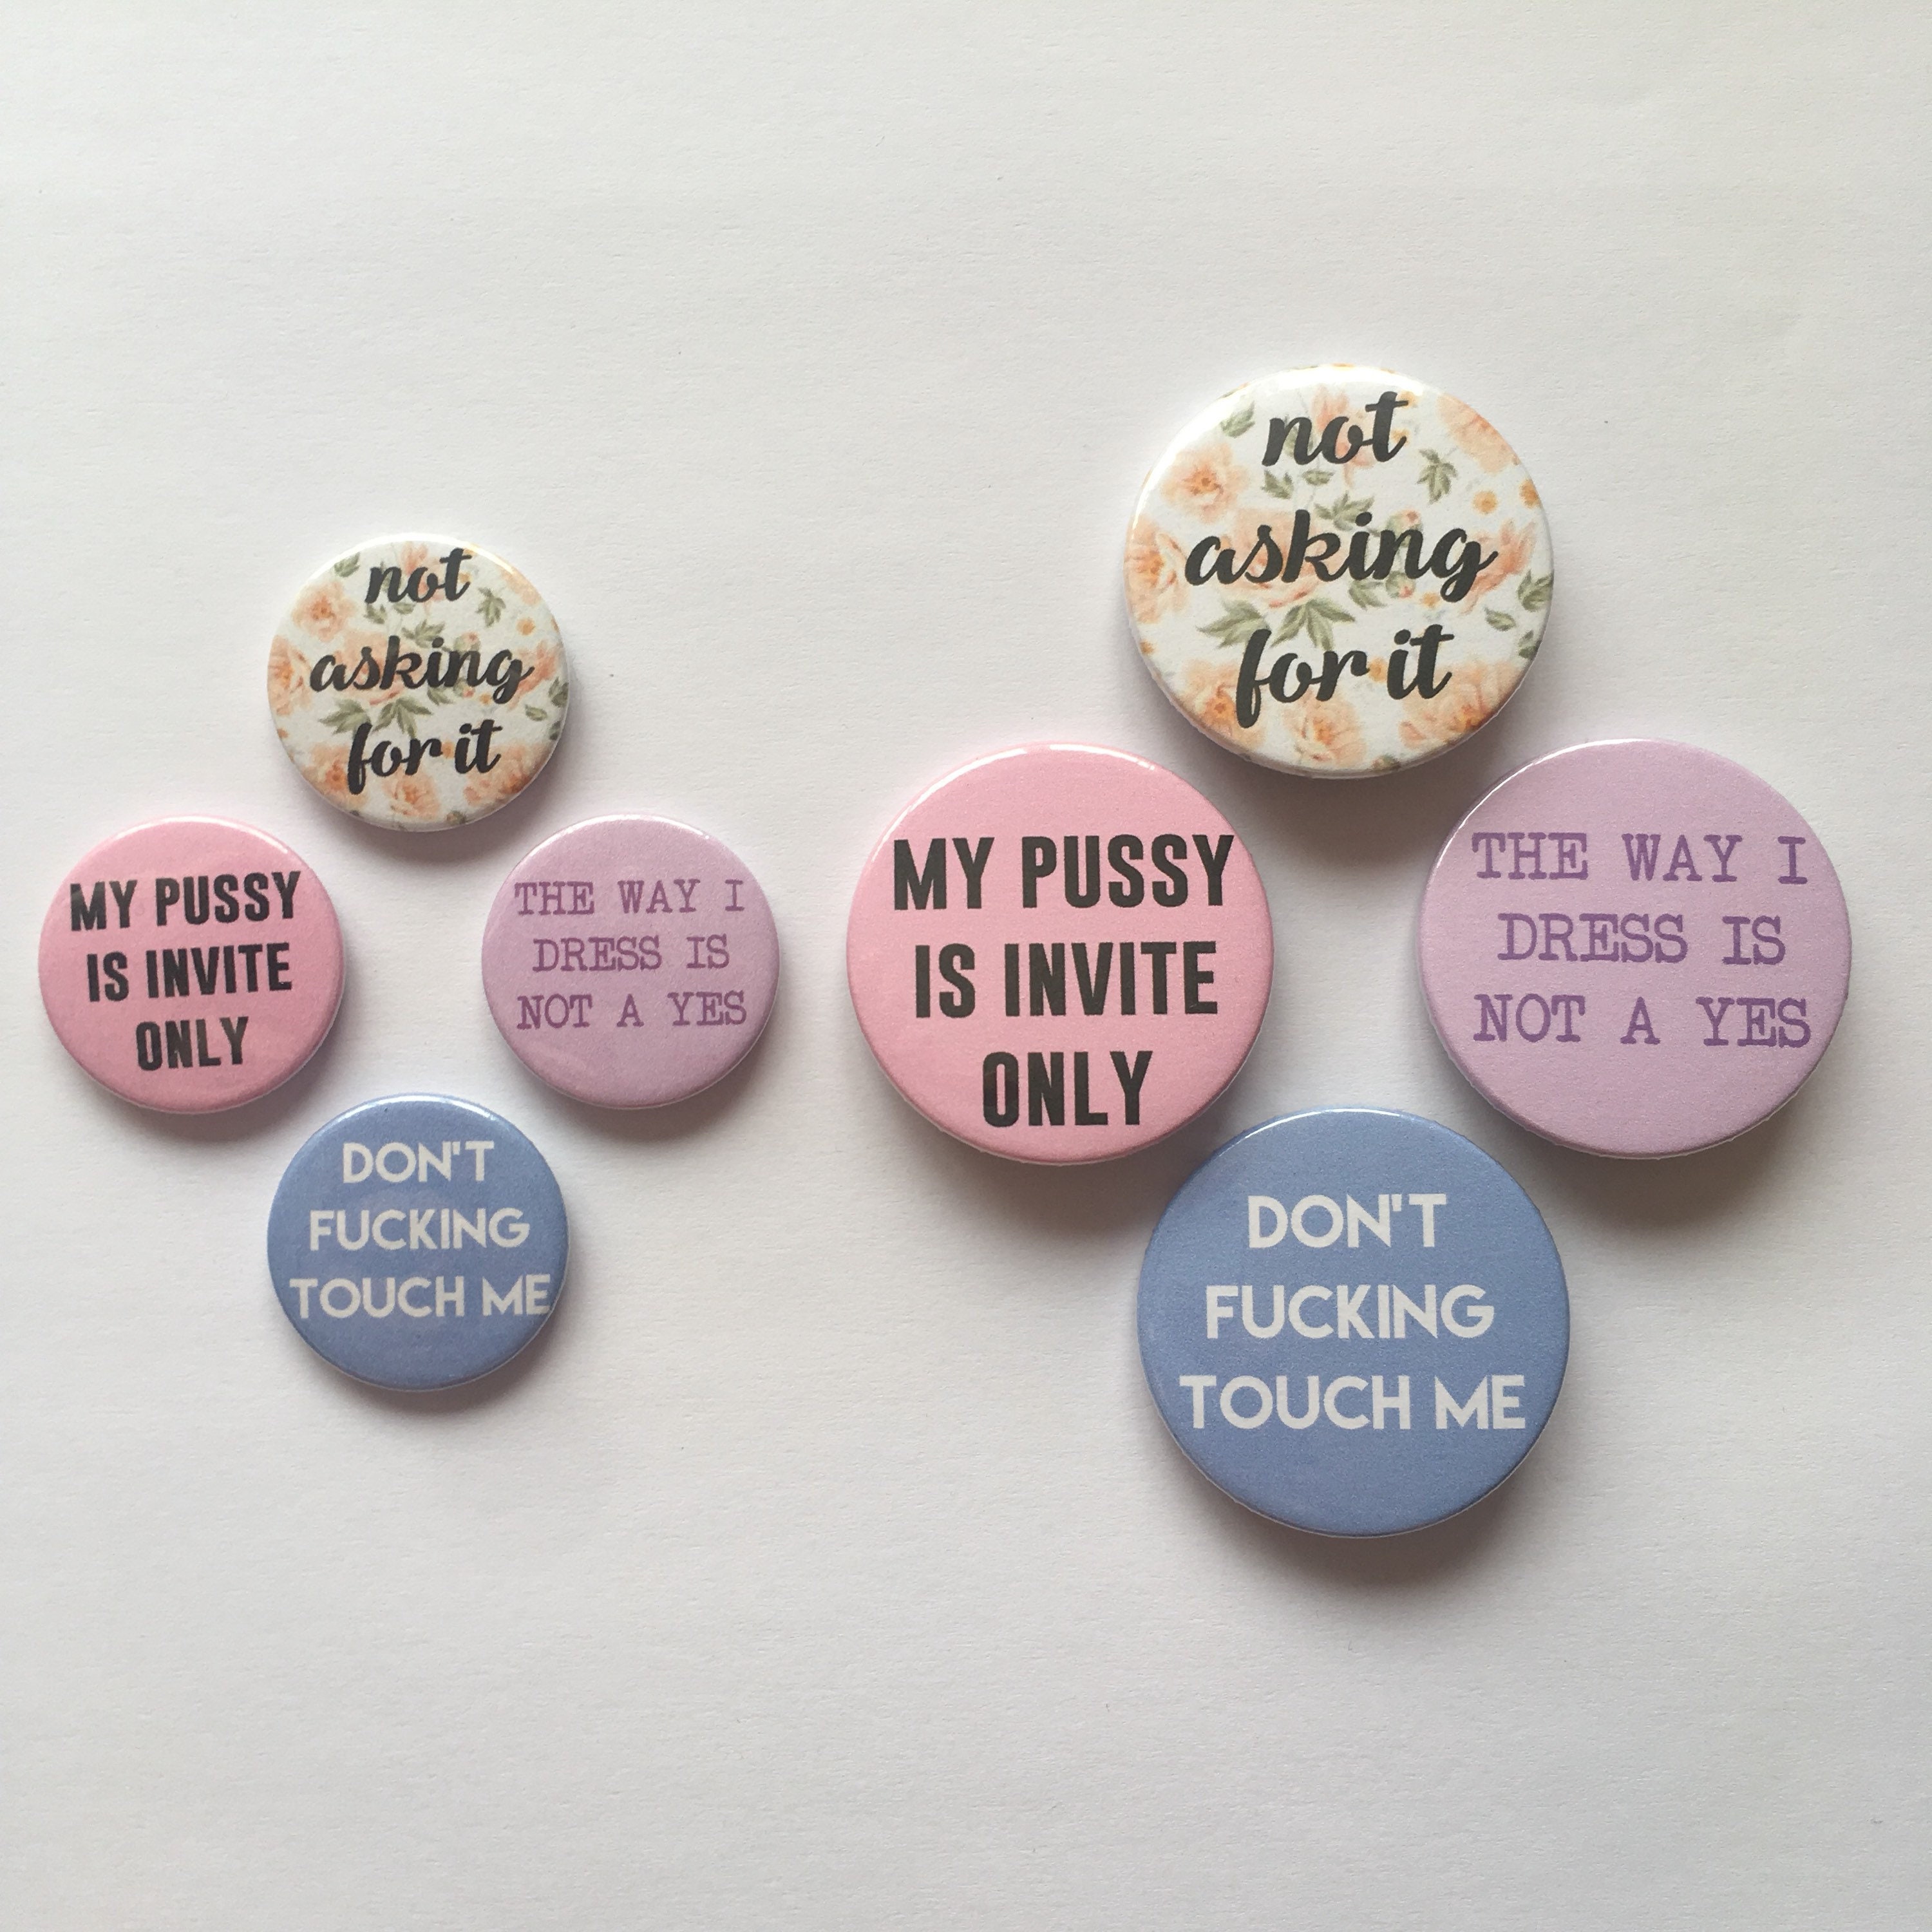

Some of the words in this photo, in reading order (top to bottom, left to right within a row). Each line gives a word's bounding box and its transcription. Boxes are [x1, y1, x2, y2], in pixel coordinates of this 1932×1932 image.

[1262, 391, 1409, 466] not
[365, 547, 472, 603] not
[1185, 509, 1499, 603] asking
[309, 636, 535, 704] asking
[1236, 628, 1369, 728] for
[1387, 623, 1454, 700] it
[347, 723, 443, 795] for
[454, 719, 502, 774] it
[893, 837, 994, 911] MY
[1021, 834, 1235, 908] PUSSY
[1472, 831, 1588, 880] THE
[1622, 833, 1743, 883] WAY
[1777, 836, 1808, 884] I
[70, 880, 138, 931] MY
[155, 871, 301, 926] PUSSY
[515, 881, 594, 916] THE
[617, 878, 701, 914] WAY
[724, 879, 744, 912] I
[532, 935, 662, 972] DRESS
[687, 934, 730, 969] IS
[1497, 912, 1688, 963] DRESS
[1722, 915, 1786, 965] IS
[86, 952, 129, 1002] IS
[146, 942, 292, 998] INVITE
[914, 943, 976, 1018] IS
[1005, 940, 1218, 1017] INVITE
[516, 994, 593, 1029] NOT
[616, 994, 644, 1027] A
[667, 990, 747, 1027] YES
[1473, 993, 1586, 1043] NOT
[1620, 997, 1661, 1045] A
[1695, 997, 1811, 1048] YES
[135, 1016, 249, 1071] ONLY
[982, 1050, 1153, 1128] ONLY
[343, 1141, 495, 1184] DON'T
[309, 1208, 530, 1251] FUCKING
[1247, 1193, 1446, 1248] DON'T
[290, 1276, 465, 1319] TOUCH
[482, 1274, 551, 1316] ME
[1206, 1284, 1495, 1339] FUCKING
[1179, 1375, 1411, 1429] TOUCH
[1434, 1375, 1526, 1429] ME
